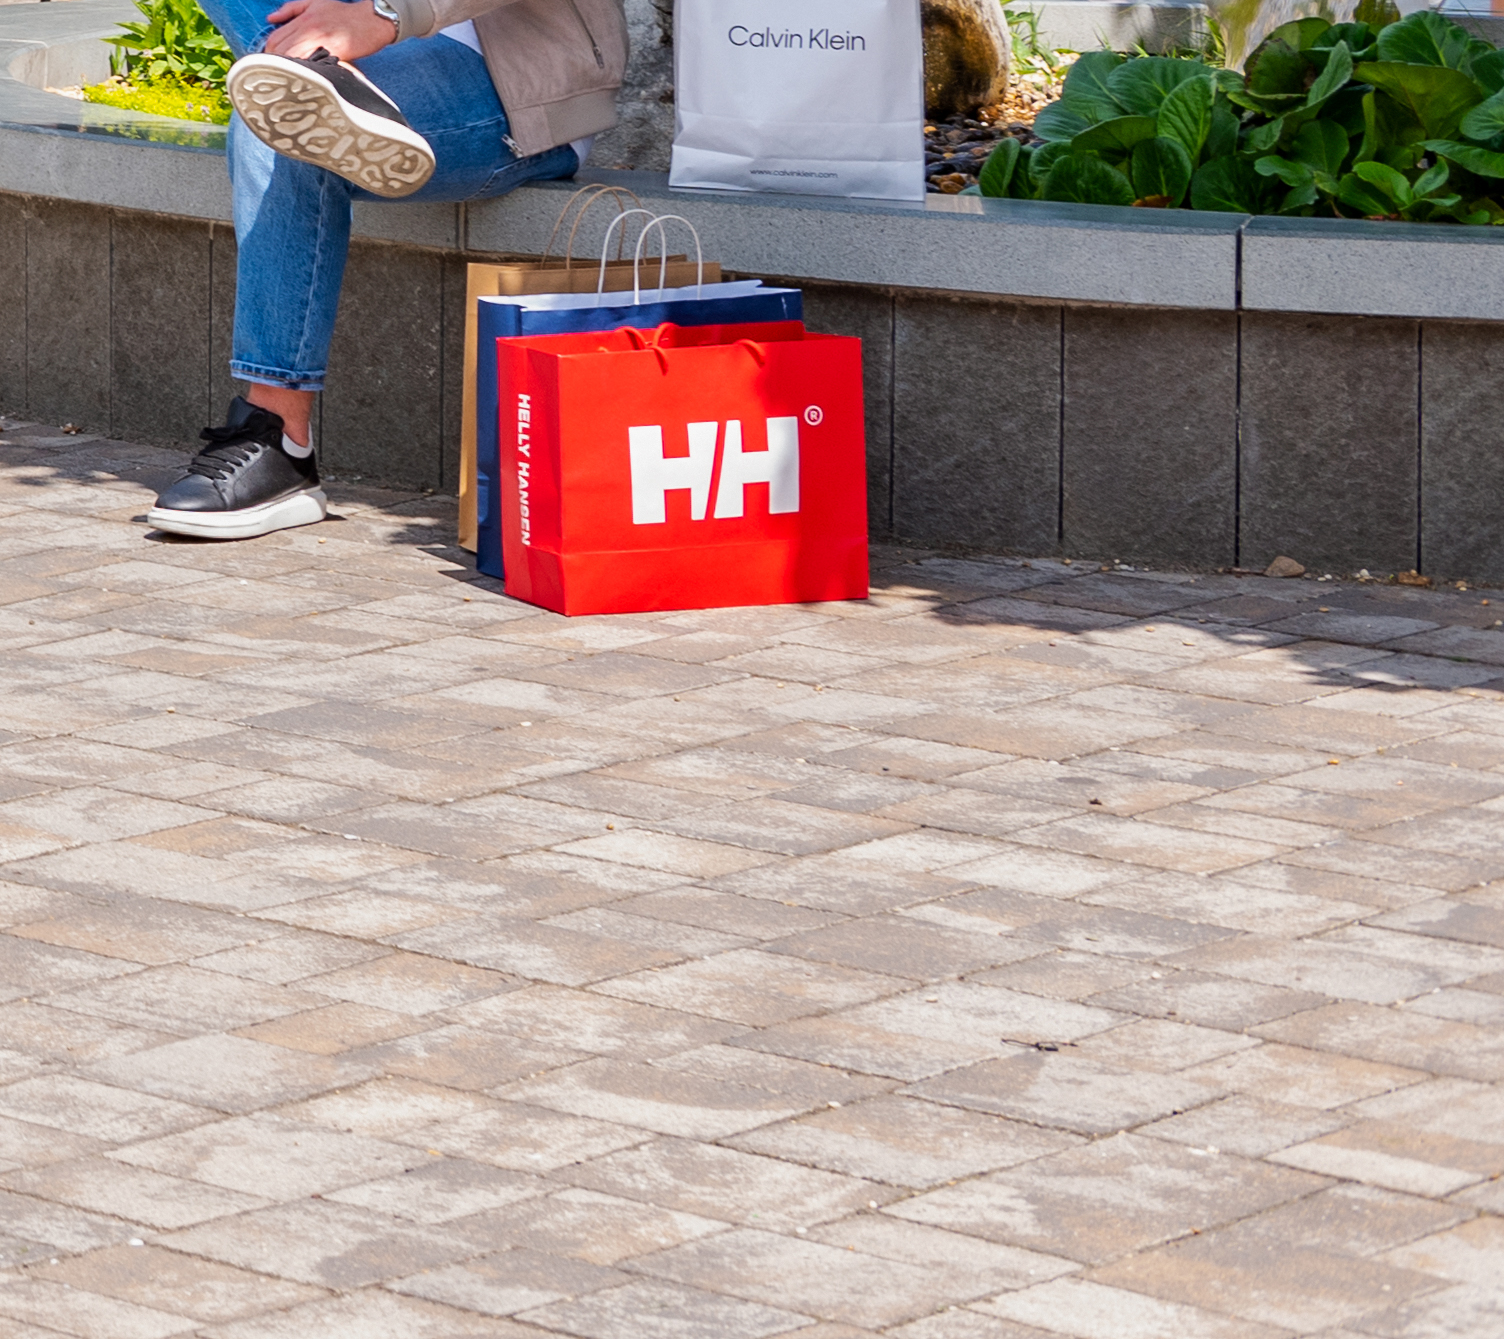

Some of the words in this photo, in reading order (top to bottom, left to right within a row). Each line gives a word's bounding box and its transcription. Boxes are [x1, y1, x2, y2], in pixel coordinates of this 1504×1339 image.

[728, 25, 803, 49] Calvin
[809, 28, 866, 51] Klein
[749, 168, 839, 179] www.calvinklein.com
[517, 392, 532, 458] HELLY
[628, 415, 800, 525] HH
[517, 461, 532, 546] HANSEN
